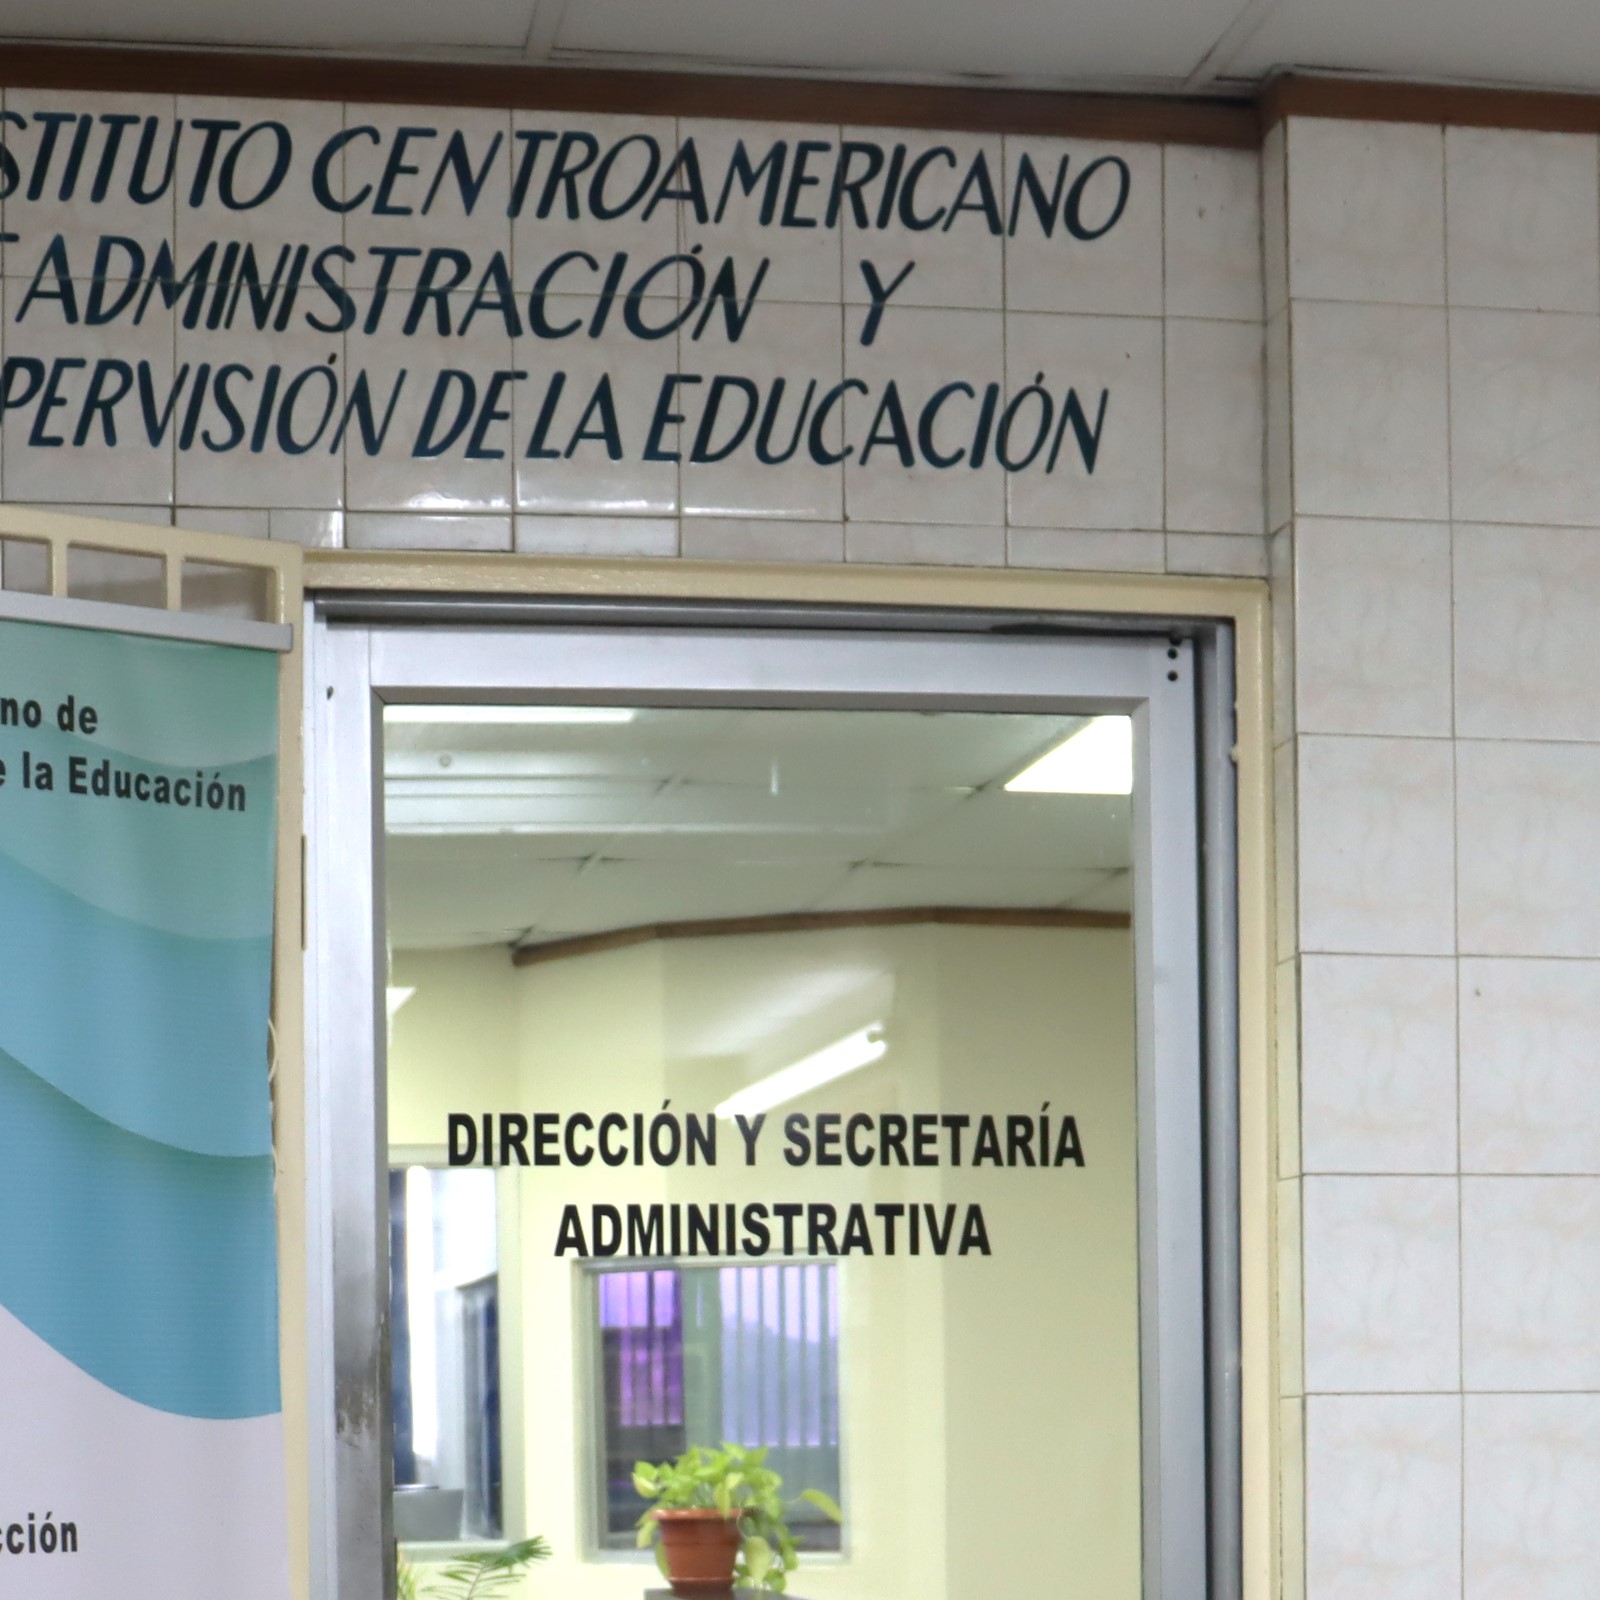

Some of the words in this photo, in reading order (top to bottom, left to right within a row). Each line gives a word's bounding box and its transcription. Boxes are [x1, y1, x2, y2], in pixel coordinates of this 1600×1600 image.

[312, 126, 1131, 241] CENTROAMERICANO
[15, 233, 770, 342] ADMINISTRACIÓN
[859, 259, 916, 347] Y
[411, 369, 528, 459] DE
[526, 371, 624, 461] LA
[641, 371, 1109, 475] EDUCACIÓN
[56, 694, 99, 736] de
[20, 751, 55, 793] la
[68, 755, 248, 814] Educación
[447, 1099, 717, 1167] DIRECCIÓN
[734, 1113, 764, 1167] Y
[782, 1101, 1086, 1168] SECRETARÍA
[554, 1203, 992, 1258] ADMINISTRATIVA
